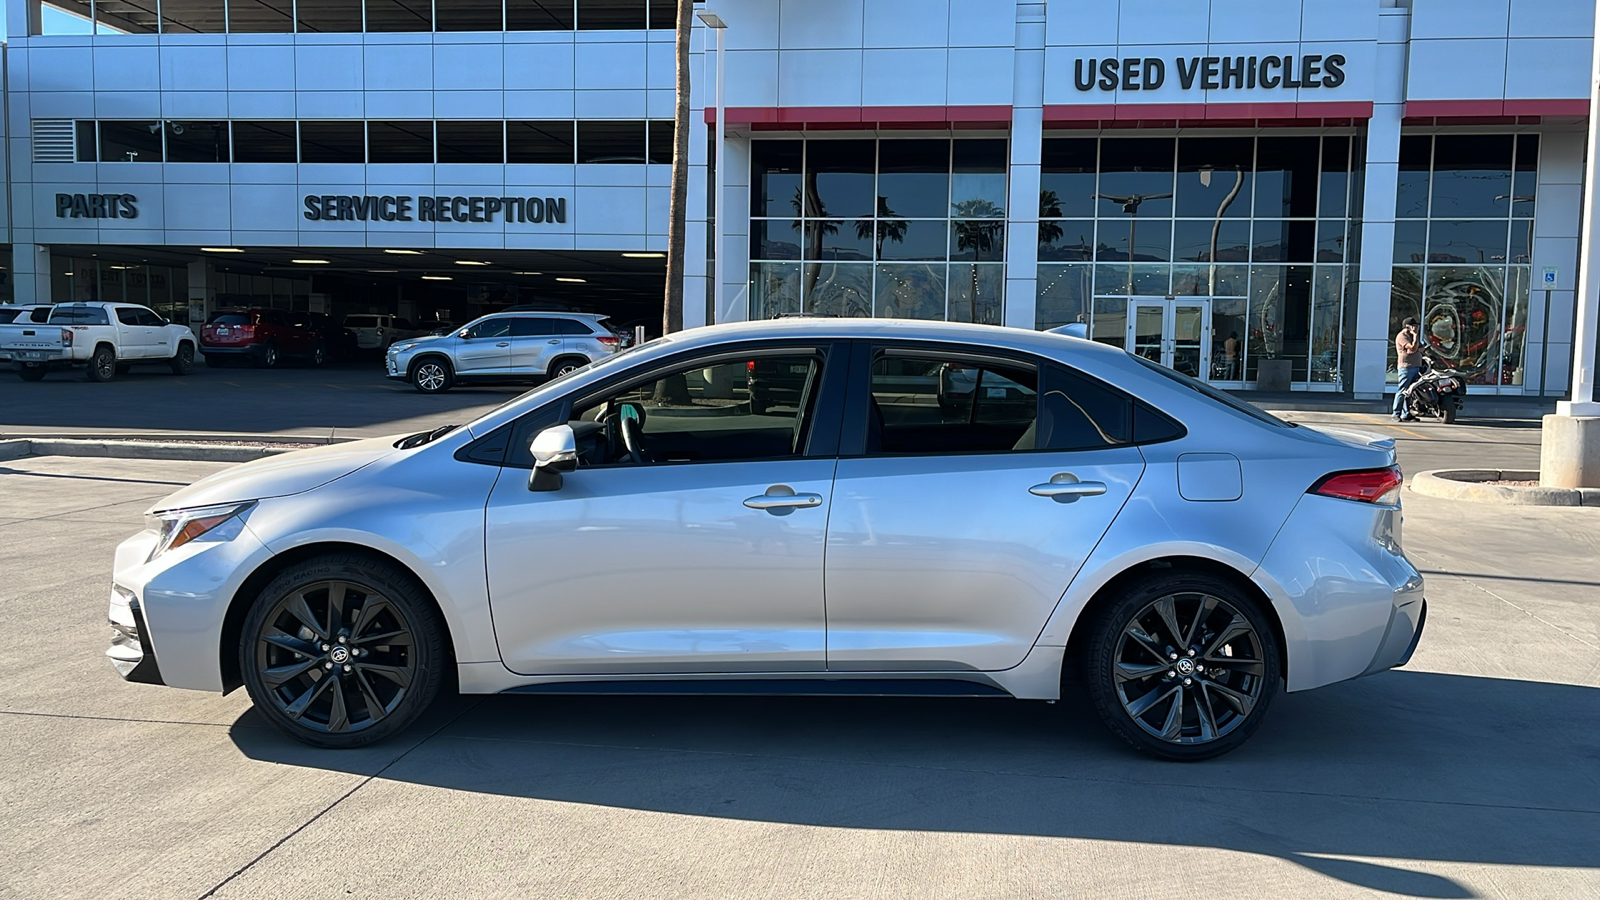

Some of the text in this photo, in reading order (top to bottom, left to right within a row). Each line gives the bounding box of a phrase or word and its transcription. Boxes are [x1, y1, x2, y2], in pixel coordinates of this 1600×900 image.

[1074, 54, 1346, 91] USED VEHICLES
[55, 193, 138, 219] PARTS
[304, 195, 566, 223] SERVICE RECEPTION
[81, 268, 119, 282] DEERT
[293, 566, 331, 582] RACING
